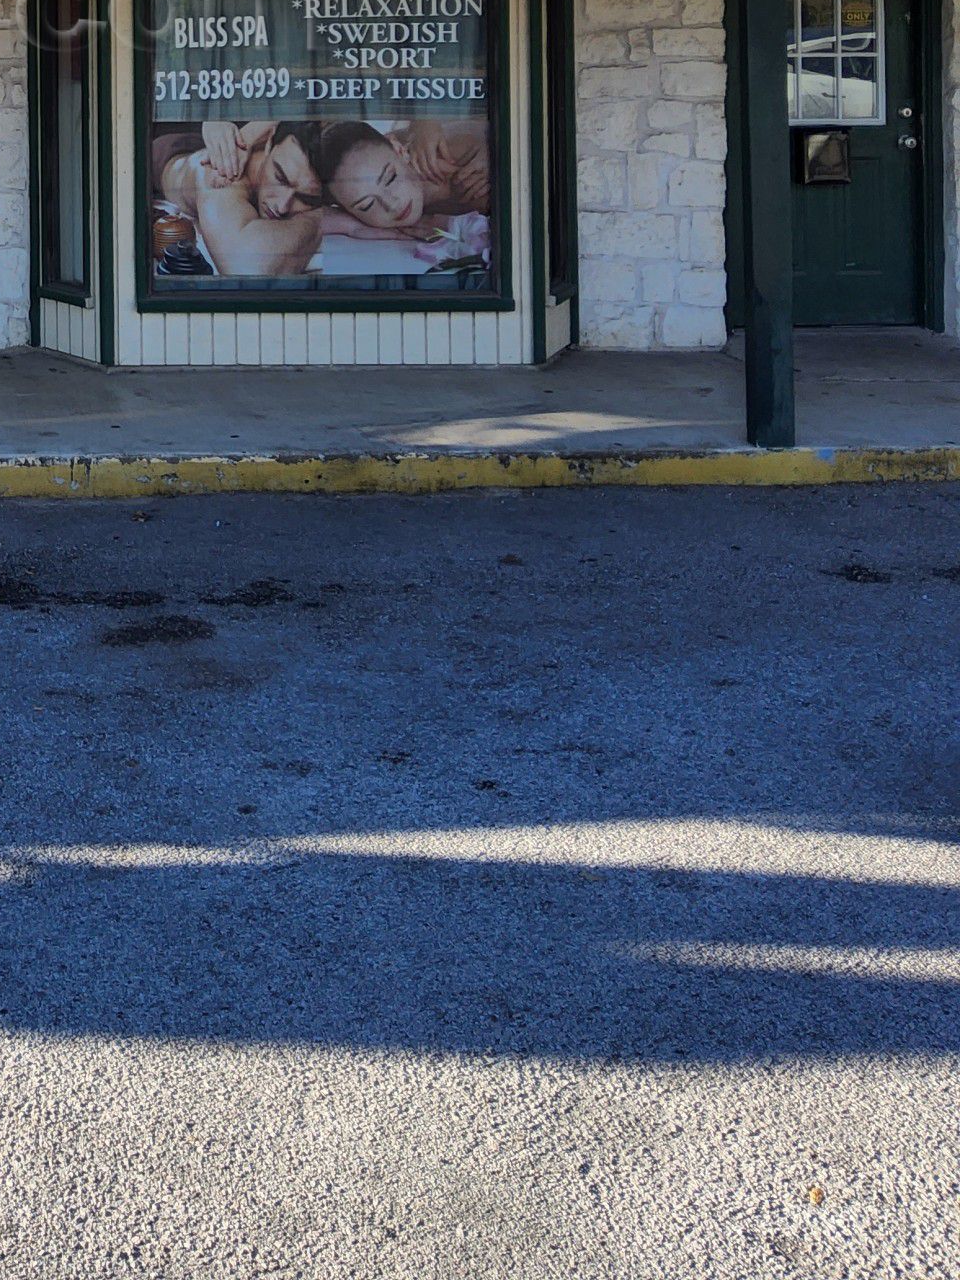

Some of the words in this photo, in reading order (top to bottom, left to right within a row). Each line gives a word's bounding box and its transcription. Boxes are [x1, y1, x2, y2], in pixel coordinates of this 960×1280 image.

[174, 16, 228, 49] BLISS
[231, 14, 269, 48] SPA
[154, 67, 291, 102] 512-838-6939
[387, 77, 486, 101] TISSUE
